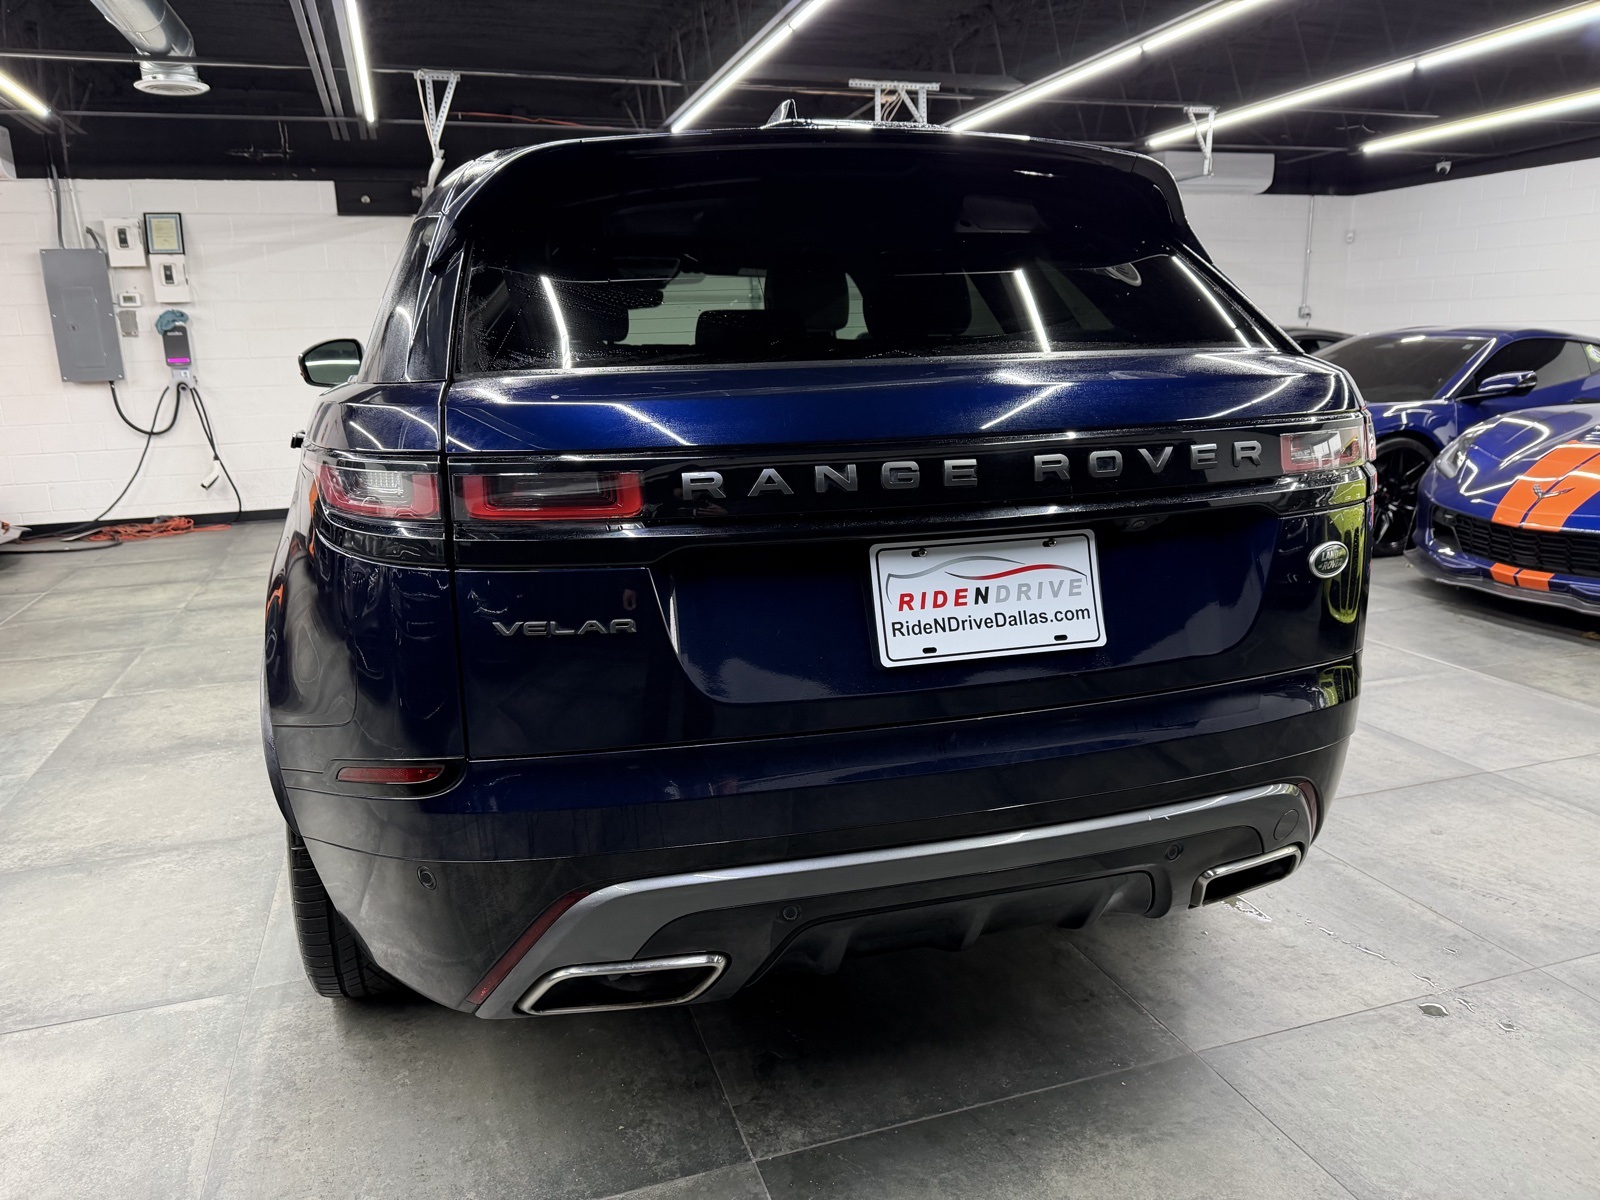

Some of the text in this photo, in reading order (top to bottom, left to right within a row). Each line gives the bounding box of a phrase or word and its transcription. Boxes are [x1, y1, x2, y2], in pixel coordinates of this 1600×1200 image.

[681, 441, 1265, 500] RANGE ROVER
[1321, 550, 1339, 562] LAND
[898, 578, 1082, 612] RIDENDRIVE
[492, 618, 637, 636] VELAR
[891, 607, 1091, 638] RideNDriveDallas.com
